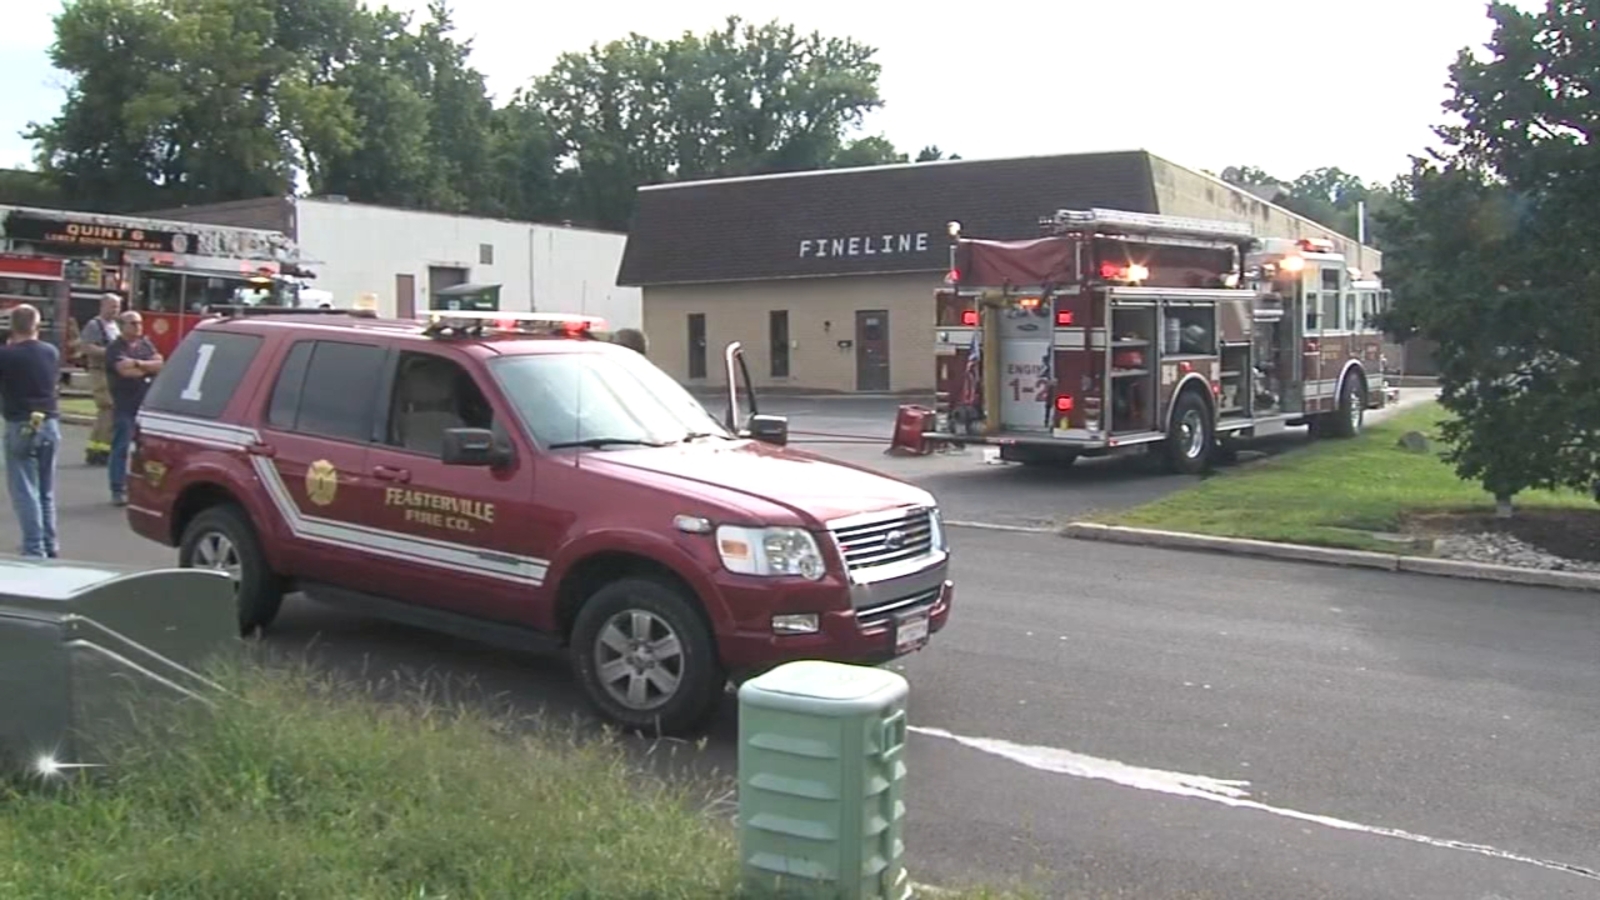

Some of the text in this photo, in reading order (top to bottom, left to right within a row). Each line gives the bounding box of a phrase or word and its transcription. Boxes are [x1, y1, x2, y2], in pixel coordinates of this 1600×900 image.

[66, 224, 124, 239] QUINT
[799, 233, 929, 258] FINELINE
[180, 344, 216, 400] 1
[1008, 364, 1047, 375] ENGIN
[385, 487, 495, 523] FEASTERVILLE
[405, 509, 442, 527] FIRE
